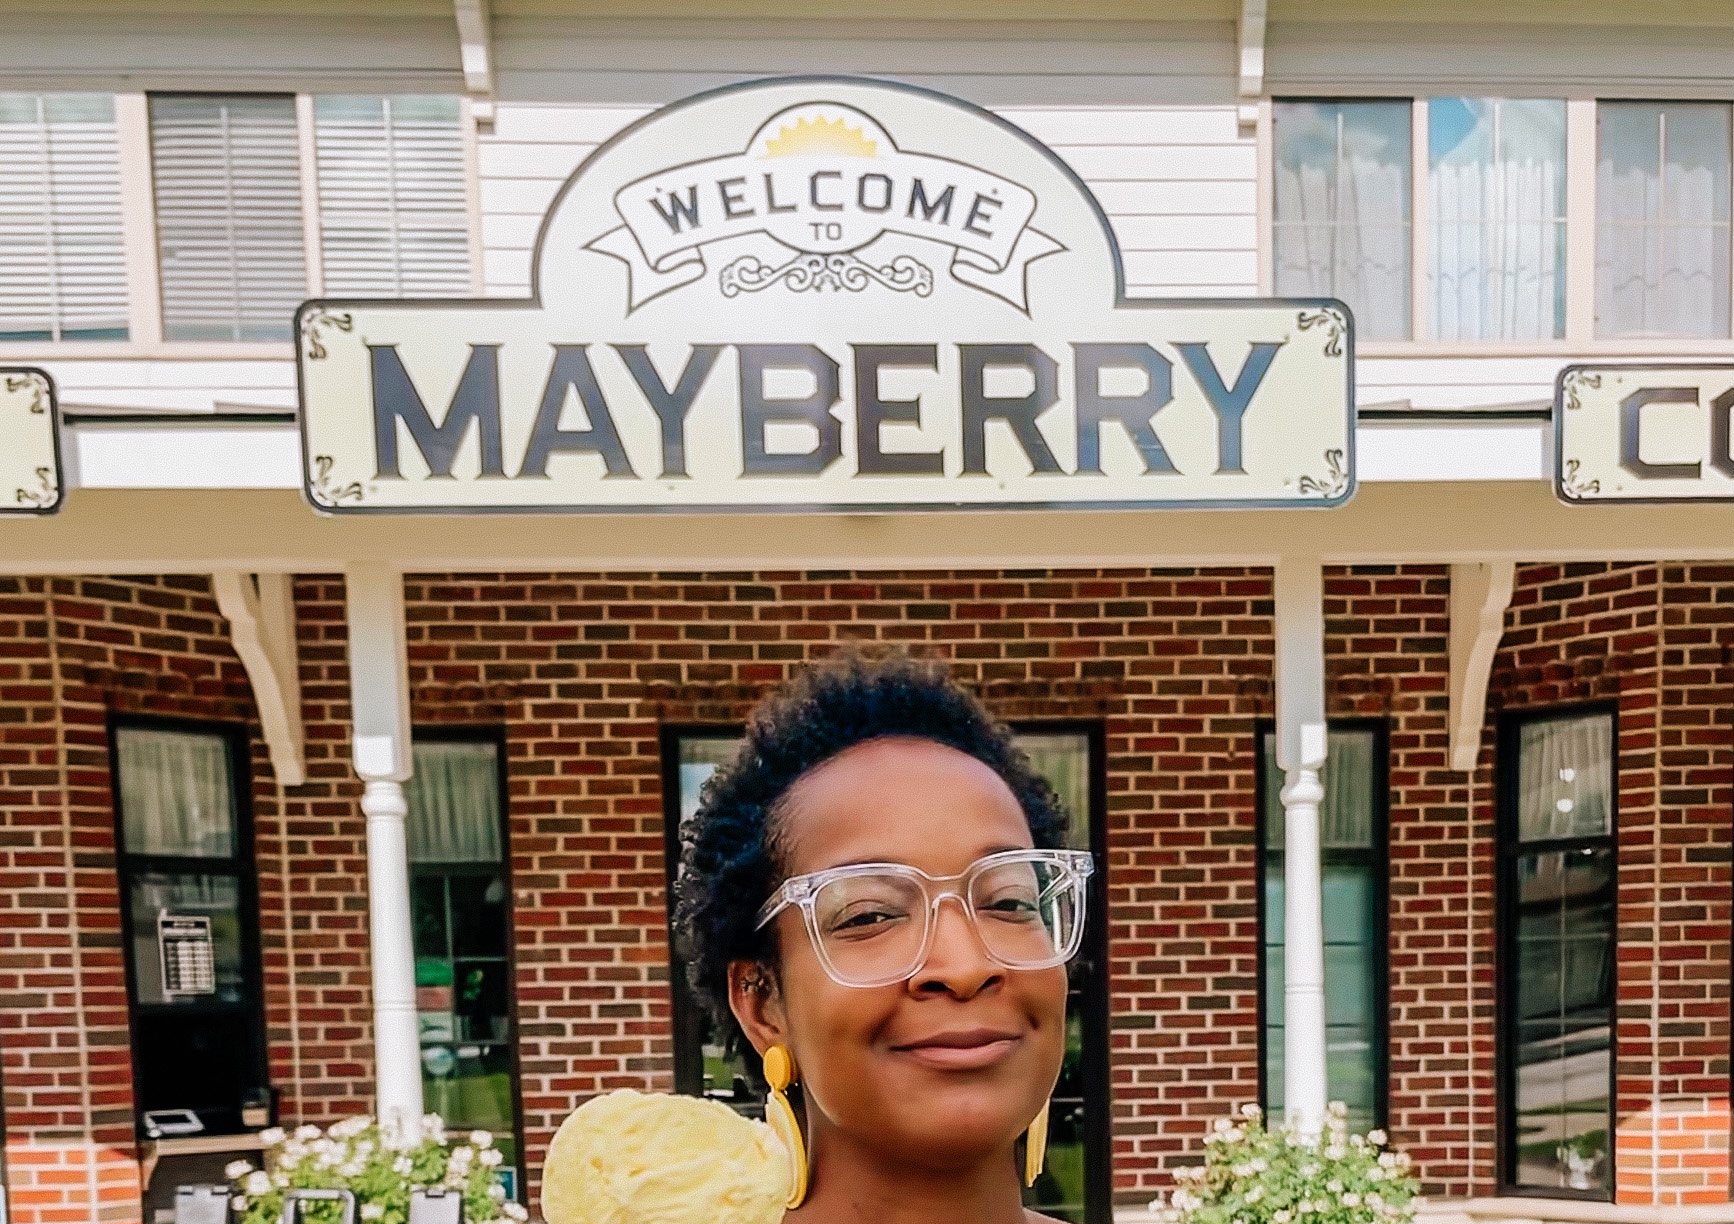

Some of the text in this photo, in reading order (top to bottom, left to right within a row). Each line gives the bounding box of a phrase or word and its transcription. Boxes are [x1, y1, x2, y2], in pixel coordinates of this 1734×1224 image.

[649, 171, 1003, 239] WELCOME
[808, 222, 842, 241] TO
[365, 341, 1288, 480] MAYBERRY
